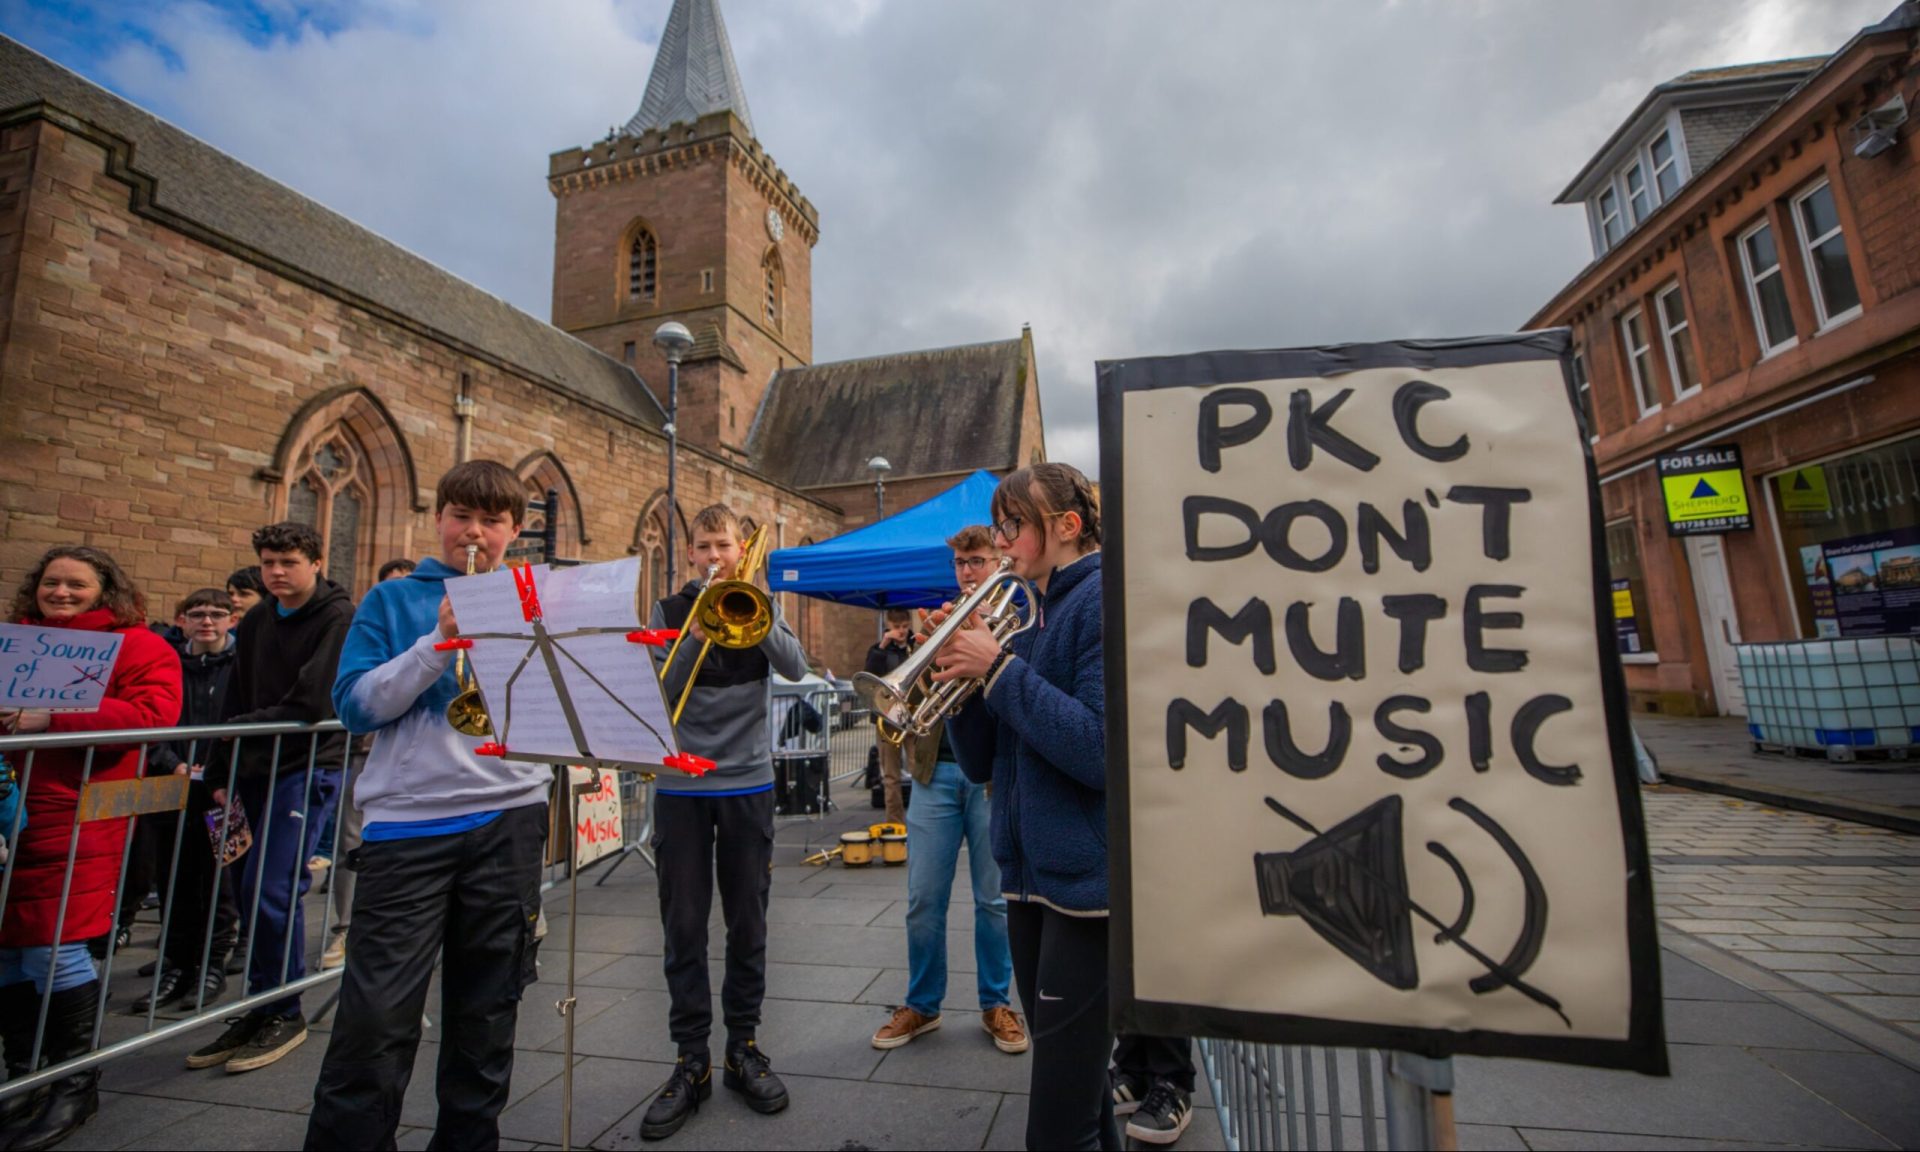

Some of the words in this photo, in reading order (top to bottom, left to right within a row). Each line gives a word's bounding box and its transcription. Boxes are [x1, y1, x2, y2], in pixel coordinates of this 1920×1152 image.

[1197, 380, 1470, 472] PKC
[1660, 456, 1693, 471] FOR
[1695, 450, 1737, 467] SALE
[1672, 494, 1740, 511] SHEPHERD
[1181, 485, 1532, 573] DON'T
[31, 632, 118, 662] Sound
[1186, 583, 1530, 681] MUTE
[14, 658, 42, 682] of
[7, 676, 88, 700] lence
[1166, 692, 1584, 786] MUSIC
[577, 816, 619, 846] MUSIC
